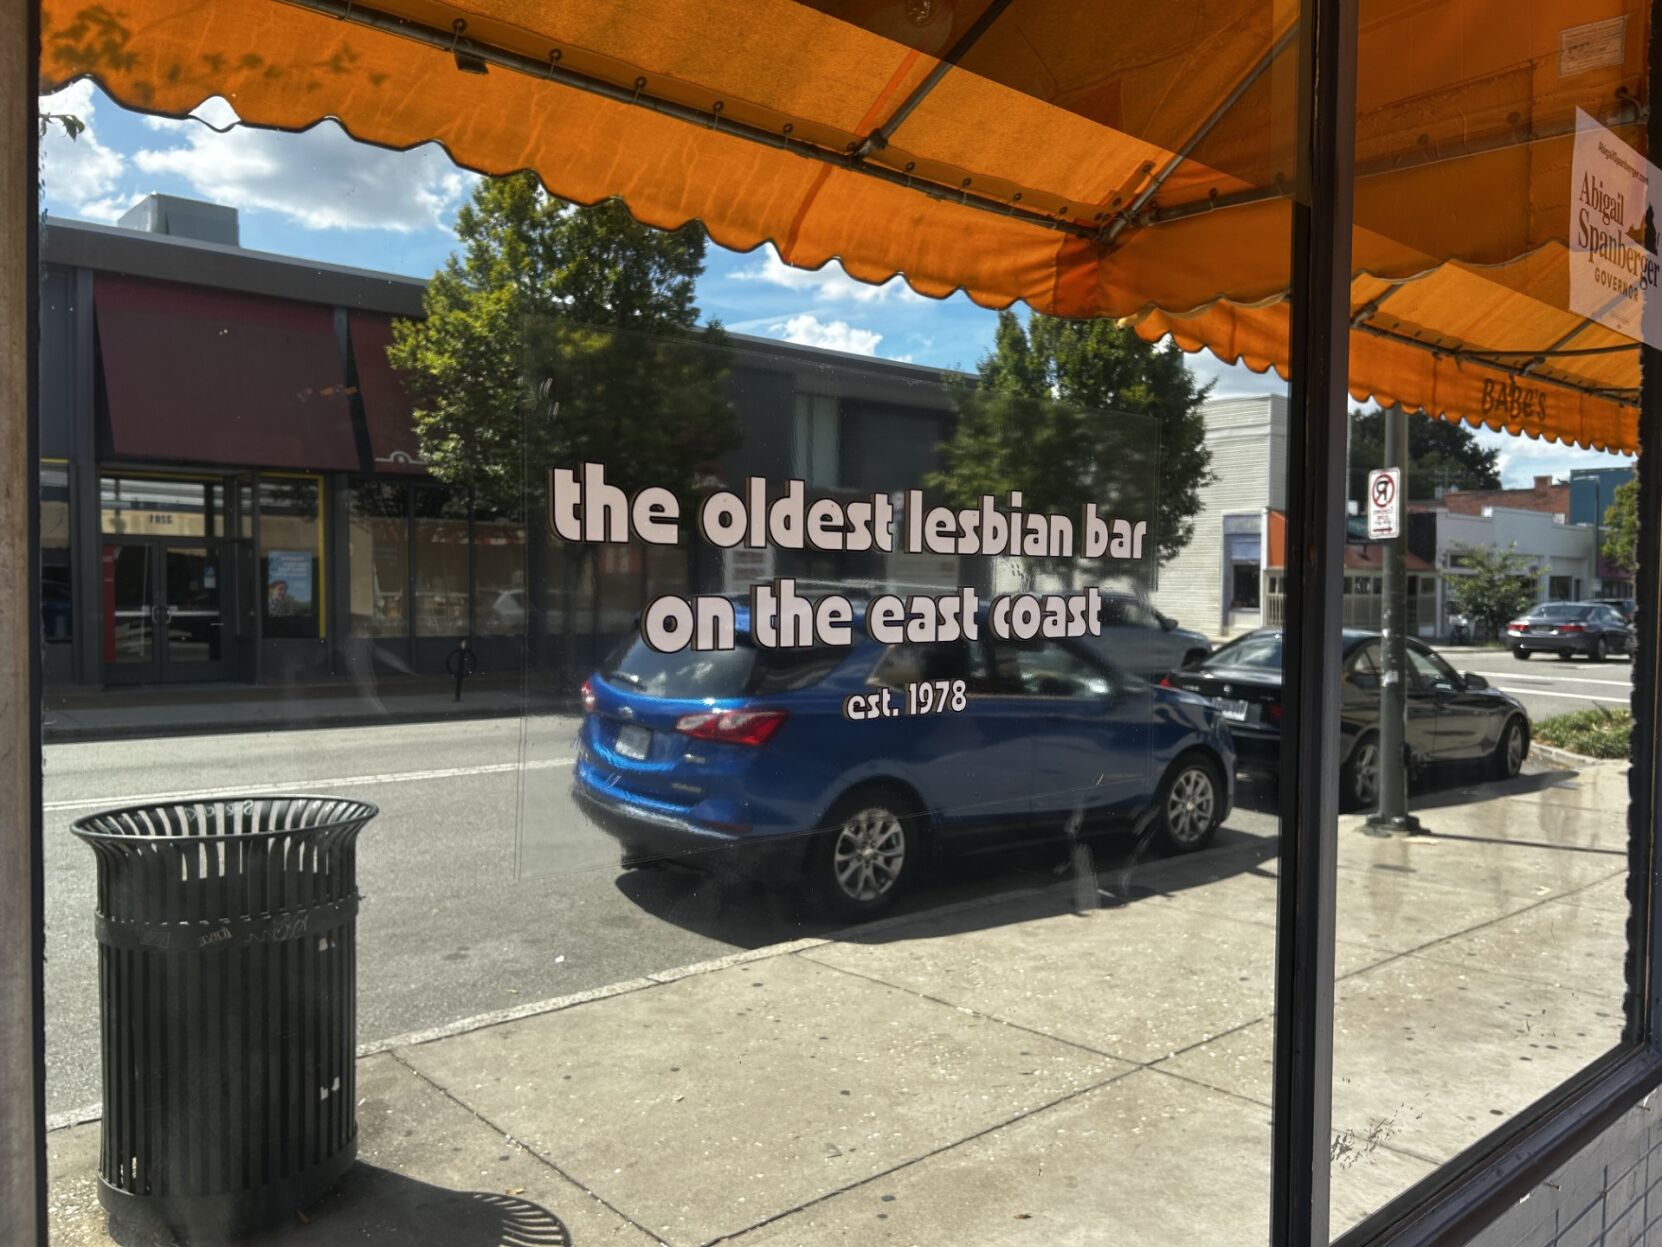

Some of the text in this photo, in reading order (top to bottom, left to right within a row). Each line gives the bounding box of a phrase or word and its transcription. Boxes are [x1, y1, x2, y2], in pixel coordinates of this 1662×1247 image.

[1580, 170, 1624, 226] Abigail
[1578, 207, 1660, 290] Spanberger
[1594, 266, 1639, 302] GOVERNOR
[1481, 378, 1547, 421] BABE'S
[550, 462, 1147, 560] the oldest lesbian bar
[642, 578, 1103, 654] on the east coast
[844, 679, 968, 720] est. 1978
